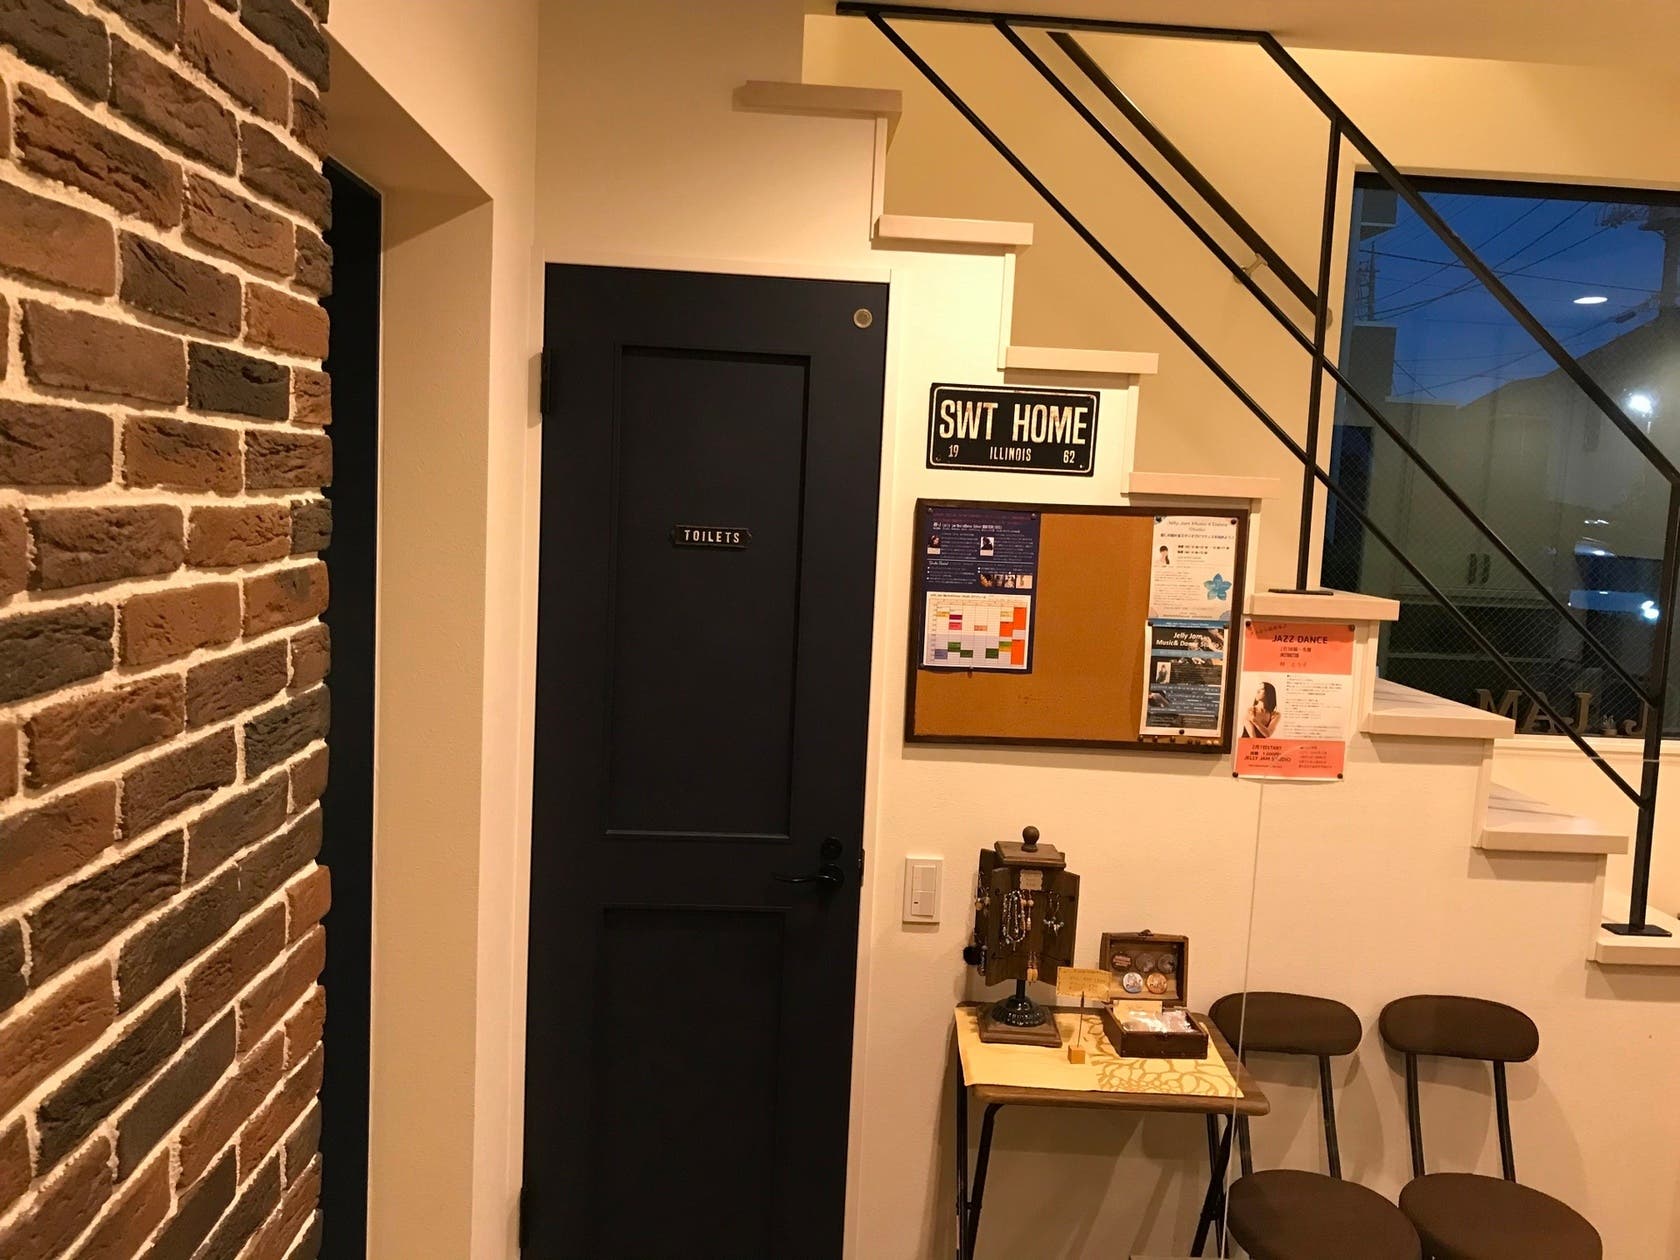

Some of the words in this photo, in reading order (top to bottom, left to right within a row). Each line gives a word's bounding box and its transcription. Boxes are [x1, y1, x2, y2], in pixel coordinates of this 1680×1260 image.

[939, 400, 999, 440] SWT
[1012, 403, 1088, 445] HOME
[948, 444, 960, 458] 19
[989, 446, 1032, 462] ILLINOIS
[1063, 450, 1076, 464] 62
[684, 529, 740, 544] TOILETS
[1173, 632, 1188, 640] Jelly
[1272, 634, 1295, 643] JAZZ
[1297, 636, 1328, 644] DANCE
